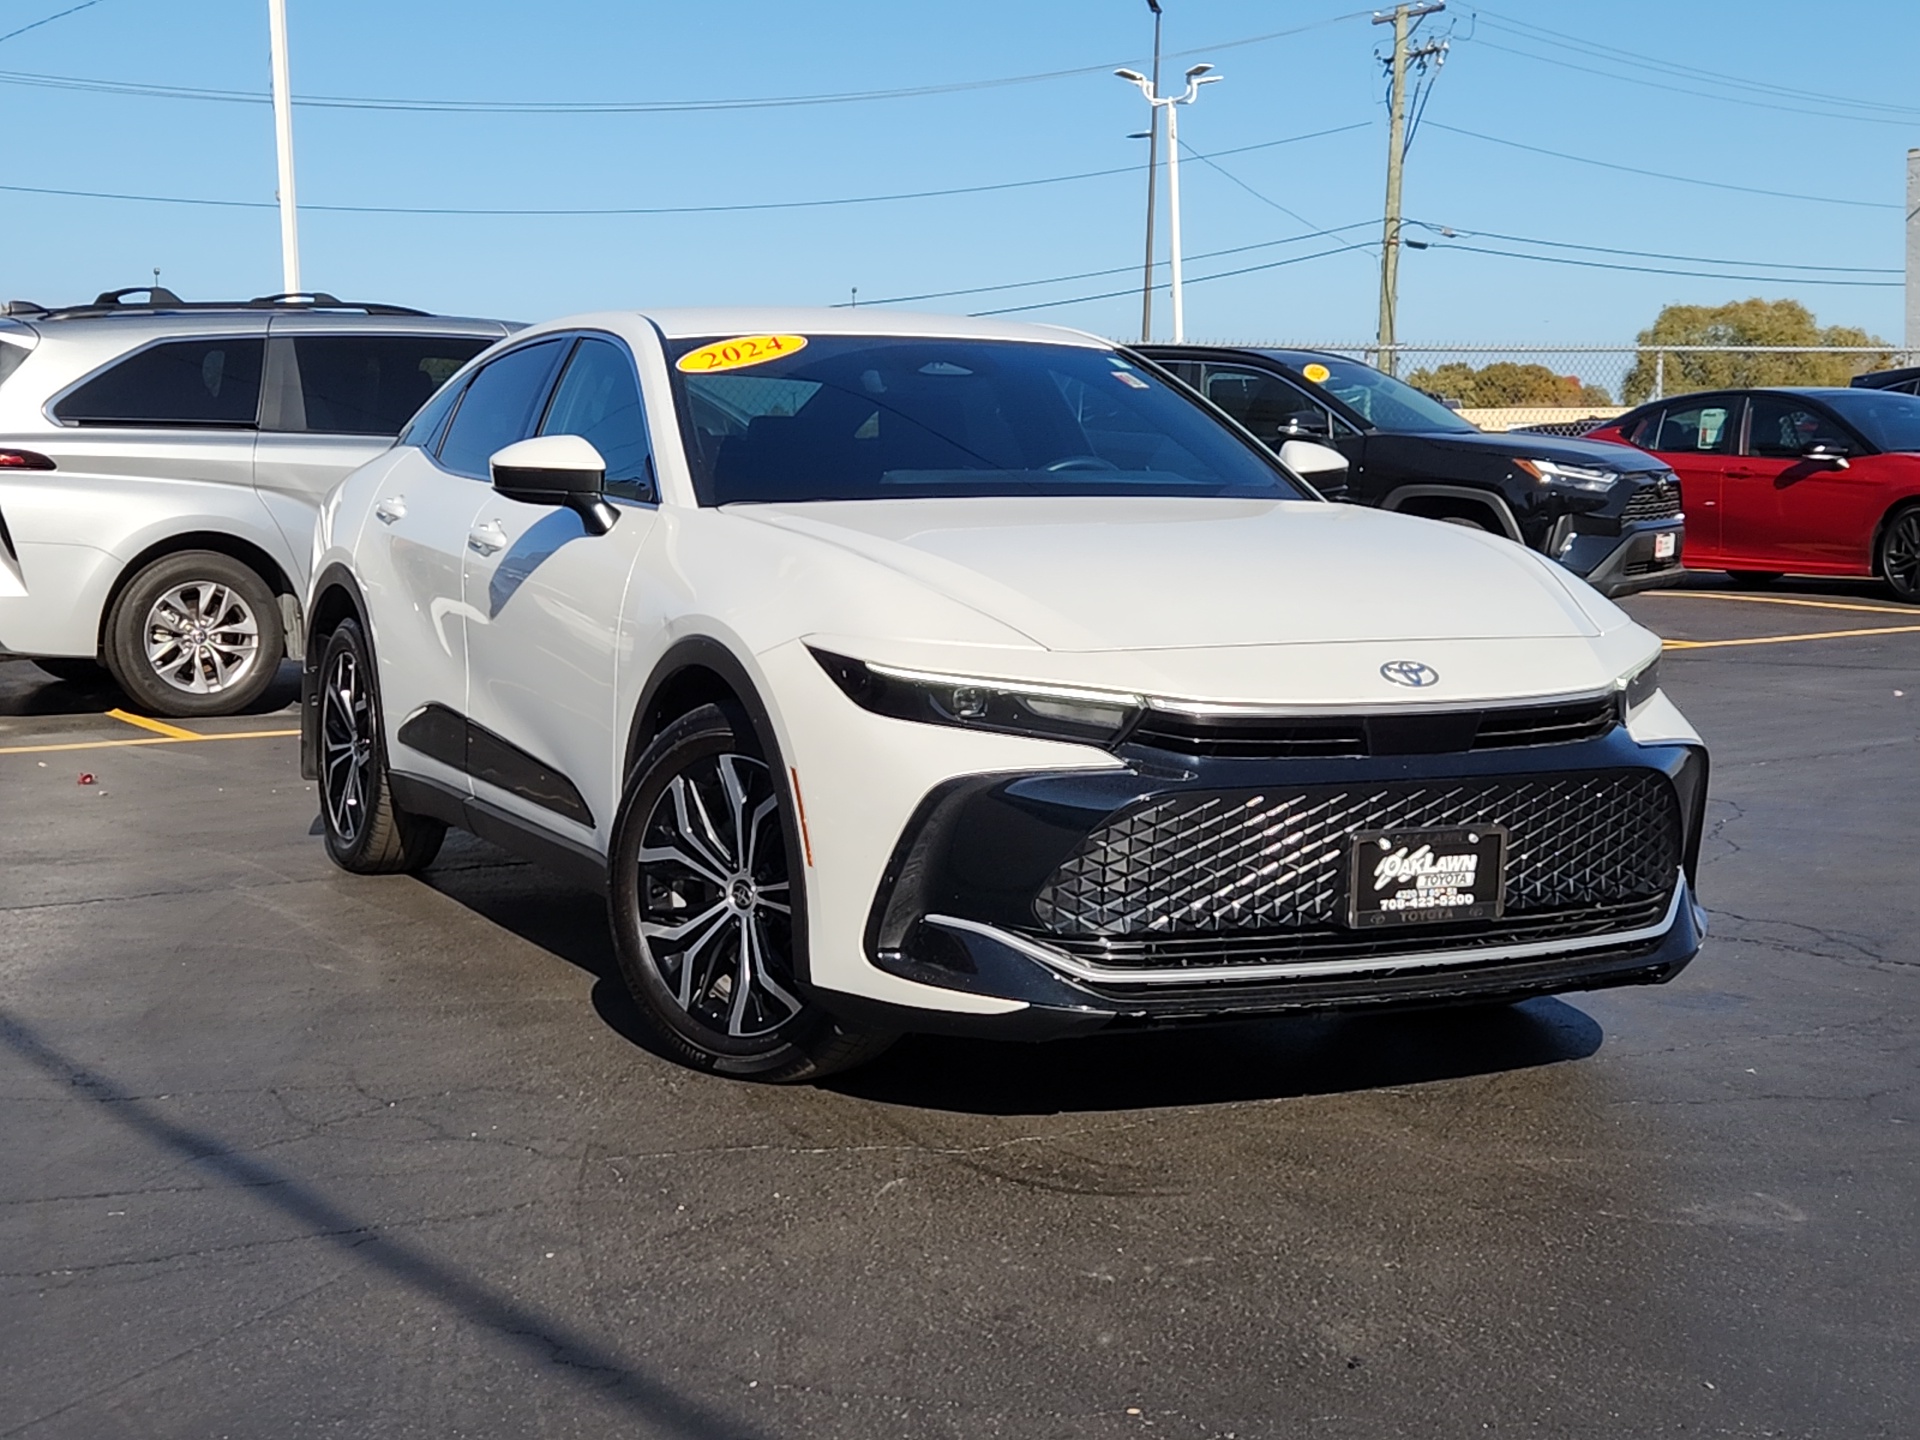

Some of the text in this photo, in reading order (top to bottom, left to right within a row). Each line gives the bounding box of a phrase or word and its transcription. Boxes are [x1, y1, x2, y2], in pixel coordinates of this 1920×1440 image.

[700, 336, 783, 369] 2024
[1423, 874, 1467, 885] TOYOTA
[1380, 894, 1475, 911] 708-423-5200
[1400, 908, 1454, 922] TOYOTA
